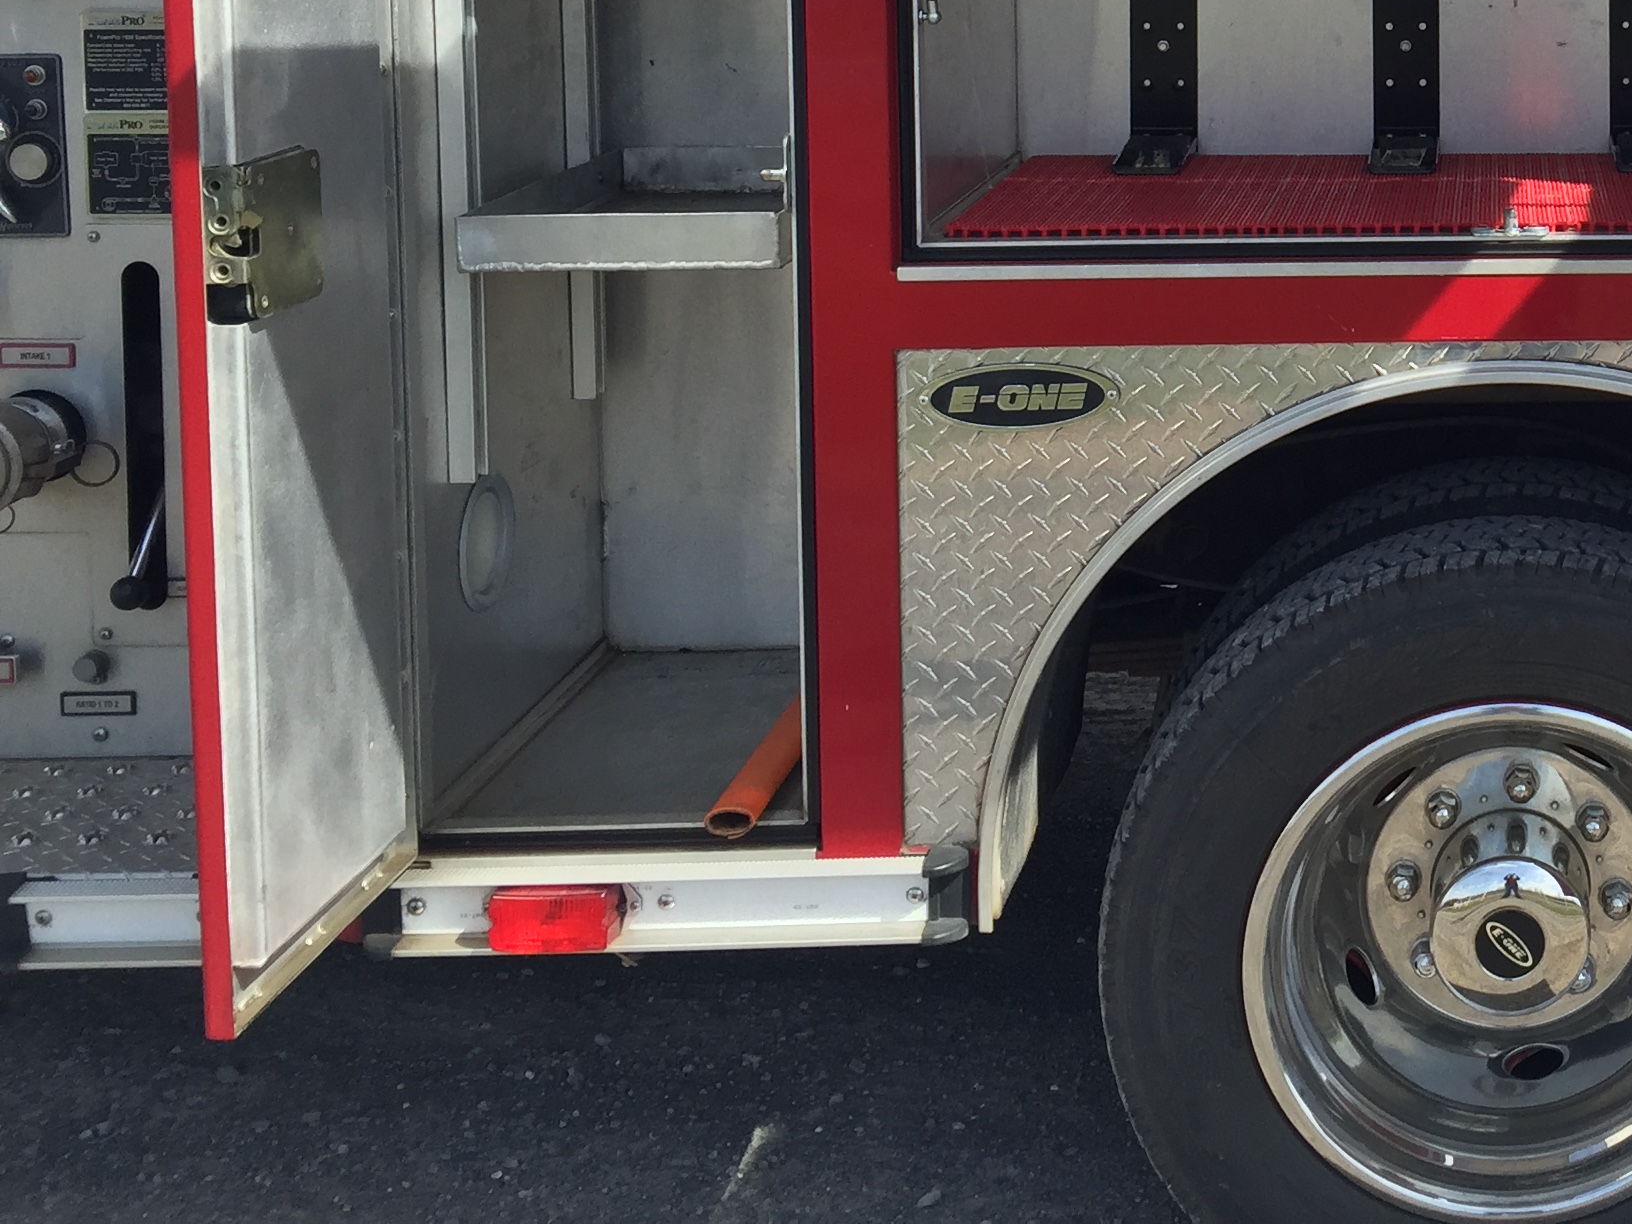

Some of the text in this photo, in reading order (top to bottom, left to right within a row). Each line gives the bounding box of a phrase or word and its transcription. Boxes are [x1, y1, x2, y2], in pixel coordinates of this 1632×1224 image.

[20, 352, 45, 360] INTAKE
[947, 382, 1089, 414] E-ONE
[1491, 927, 1527, 959] E-ONE
